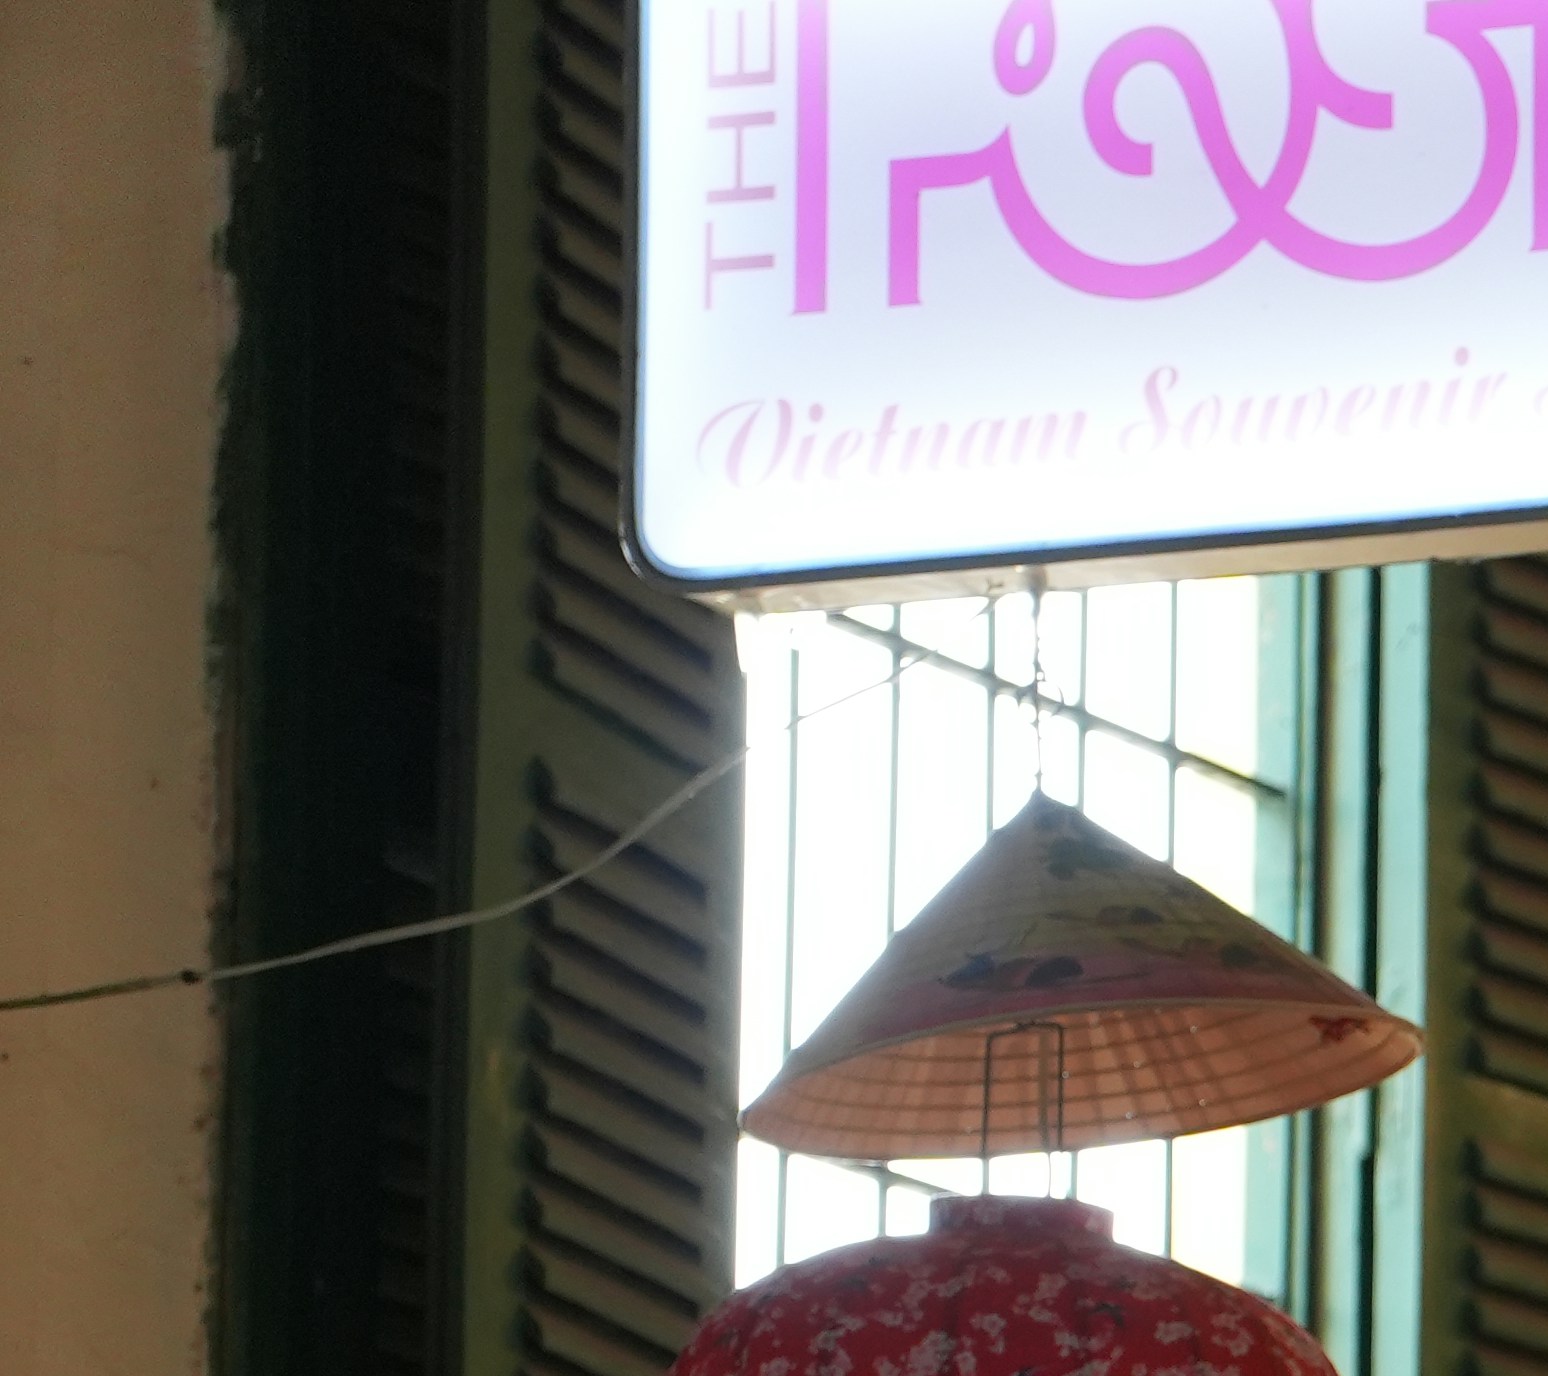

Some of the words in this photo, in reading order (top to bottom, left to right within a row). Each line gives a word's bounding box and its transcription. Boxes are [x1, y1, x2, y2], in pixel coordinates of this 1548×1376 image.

[704, 0, 778, 310] THE
[694, 391, 1090, 490] Vietnam
[1116, 343, 1510, 456] Souvenir
